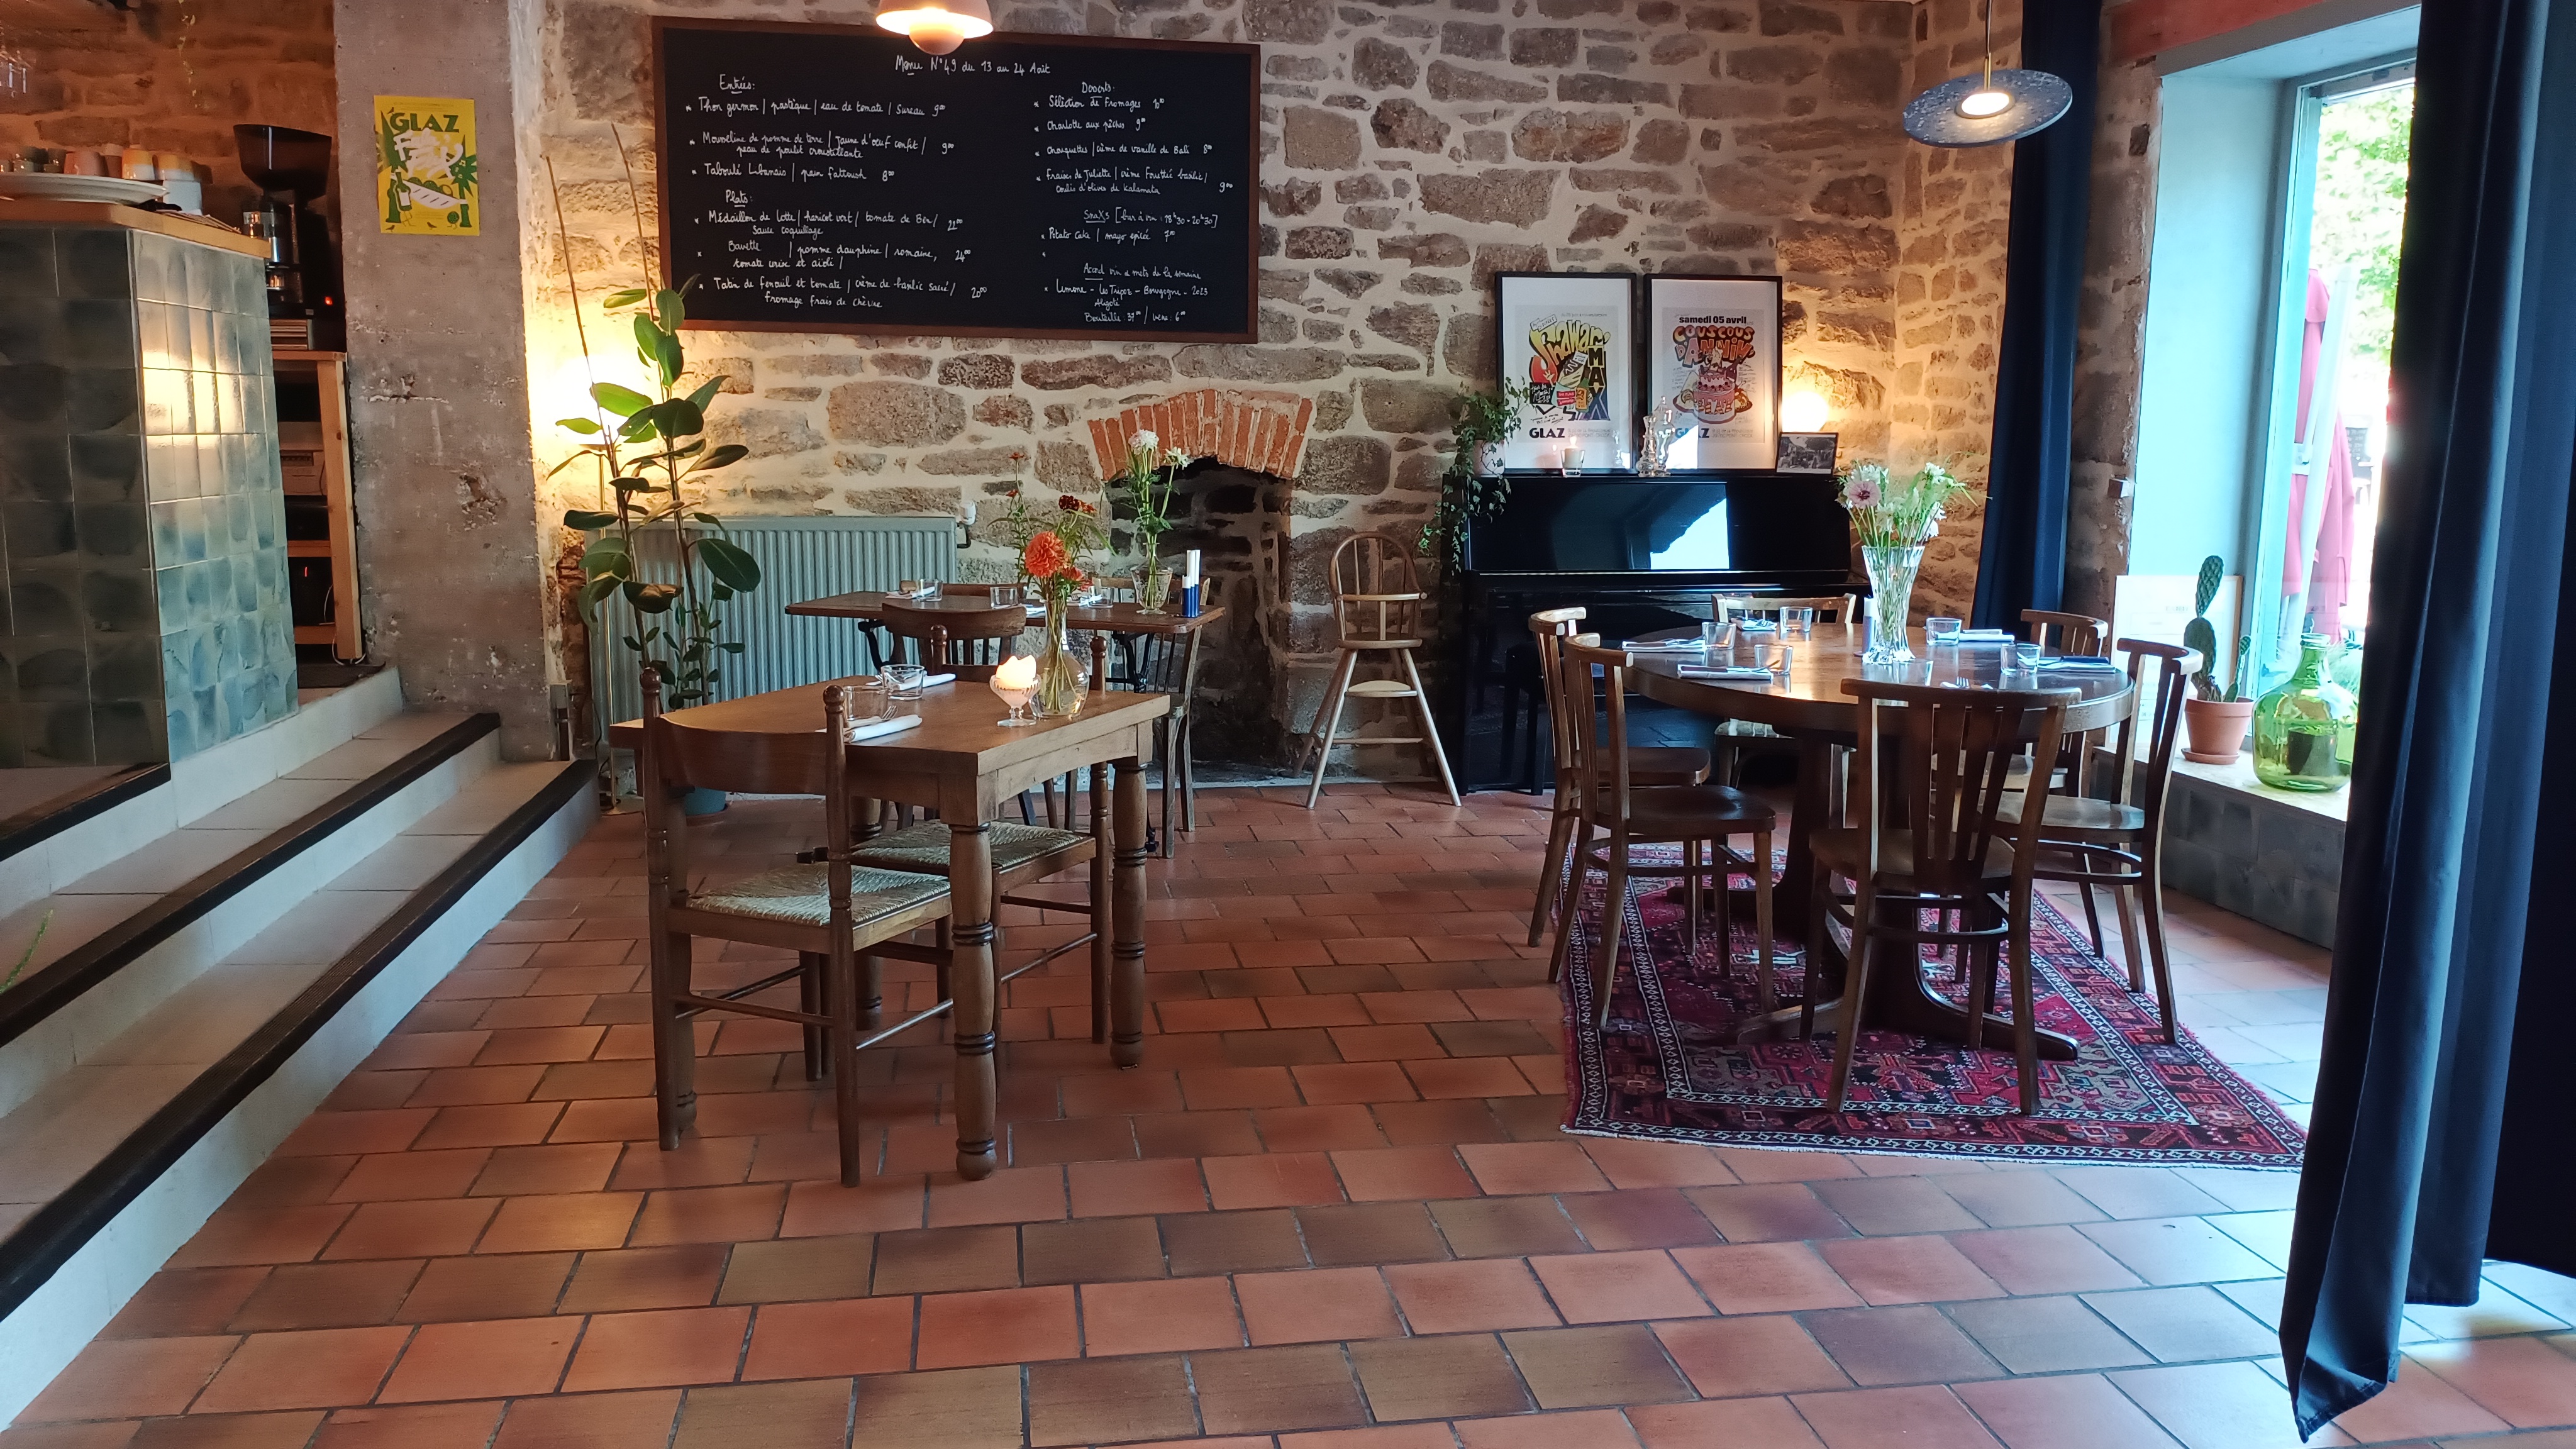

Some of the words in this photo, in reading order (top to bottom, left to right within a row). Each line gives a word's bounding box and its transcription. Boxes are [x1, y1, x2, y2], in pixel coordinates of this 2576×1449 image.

[896, 55, 923, 72] Menu
[962, 62, 975, 72] du
[981, 60, 992, 72] 13
[1014, 63, 1024, 75] 24
[699, 96, 722, 112] Thon
[727, 104, 758, 117] germon
[842, 101, 852, 111] de
[857, 101, 883, 112] tomate
[1091, 97, 1101, 106] de
[389, 112, 460, 133] GLAZ
[1047, 119, 1082, 130] Charlotte
[1103, 119, 1124, 132] pêches
[703, 131, 746, 143] Mousseline
[749, 133, 758, 143] de
[762, 135, 791, 148] pomme
[794, 134, 803, 143] de
[895, 138, 918, 152] confit
[1119, 144, 1128, 152] de
[1131, 143, 1156, 153] vanille
[1160, 145, 1169, 153] de
[736, 146, 757, 157] peau
[761, 145, 770, 153] de
[776, 145, 804, 158] poulet
[809, 147, 863, 158] croustillante
[704, 162, 741, 175] Taboulé
[749, 163, 786, 176] Libanais
[801, 169, 823, 182] pain
[1075, 169, 1082, 179] de
[1084, 168, 1111, 182] Juliette
[1111, 183, 1119, 192] de
[709, 210, 756, 223] Médaillon
[760, 211, 770, 221] de
[777, 209, 796, 222] lotte
[866, 211, 896, 222] tomate
[901, 214, 910, 223] de
[1138, 211, 1143, 221] à
[1049, 227, 1072, 239] Potato
[1105, 233, 1127, 244] mayo
[729, 240, 760, 252] Bavette
[797, 247, 833, 260] pomme
[837, 245, 882, 258] dauphine
[733, 258, 763, 268] tomate
[796, 258, 806, 267] et
[1132, 267, 1148, 277] mets
[1153, 266, 1161, 276] de
[1163, 267, 1172, 278] la
[714, 277, 740, 289] Tatin
[744, 279, 754, 288] de
[760, 276, 792, 289] fenouil
[796, 278, 806, 287] et
[811, 277, 841, 289] tomate
[855, 275, 877, 288] crème
[880, 279, 890, 288] de
[836, 297, 846, 306] de
[1674, 325, 1754, 343] COUSCOUS
[1529, 428, 1565, 438] GLAZ
[1675, 428, 1709, 438] GZ
